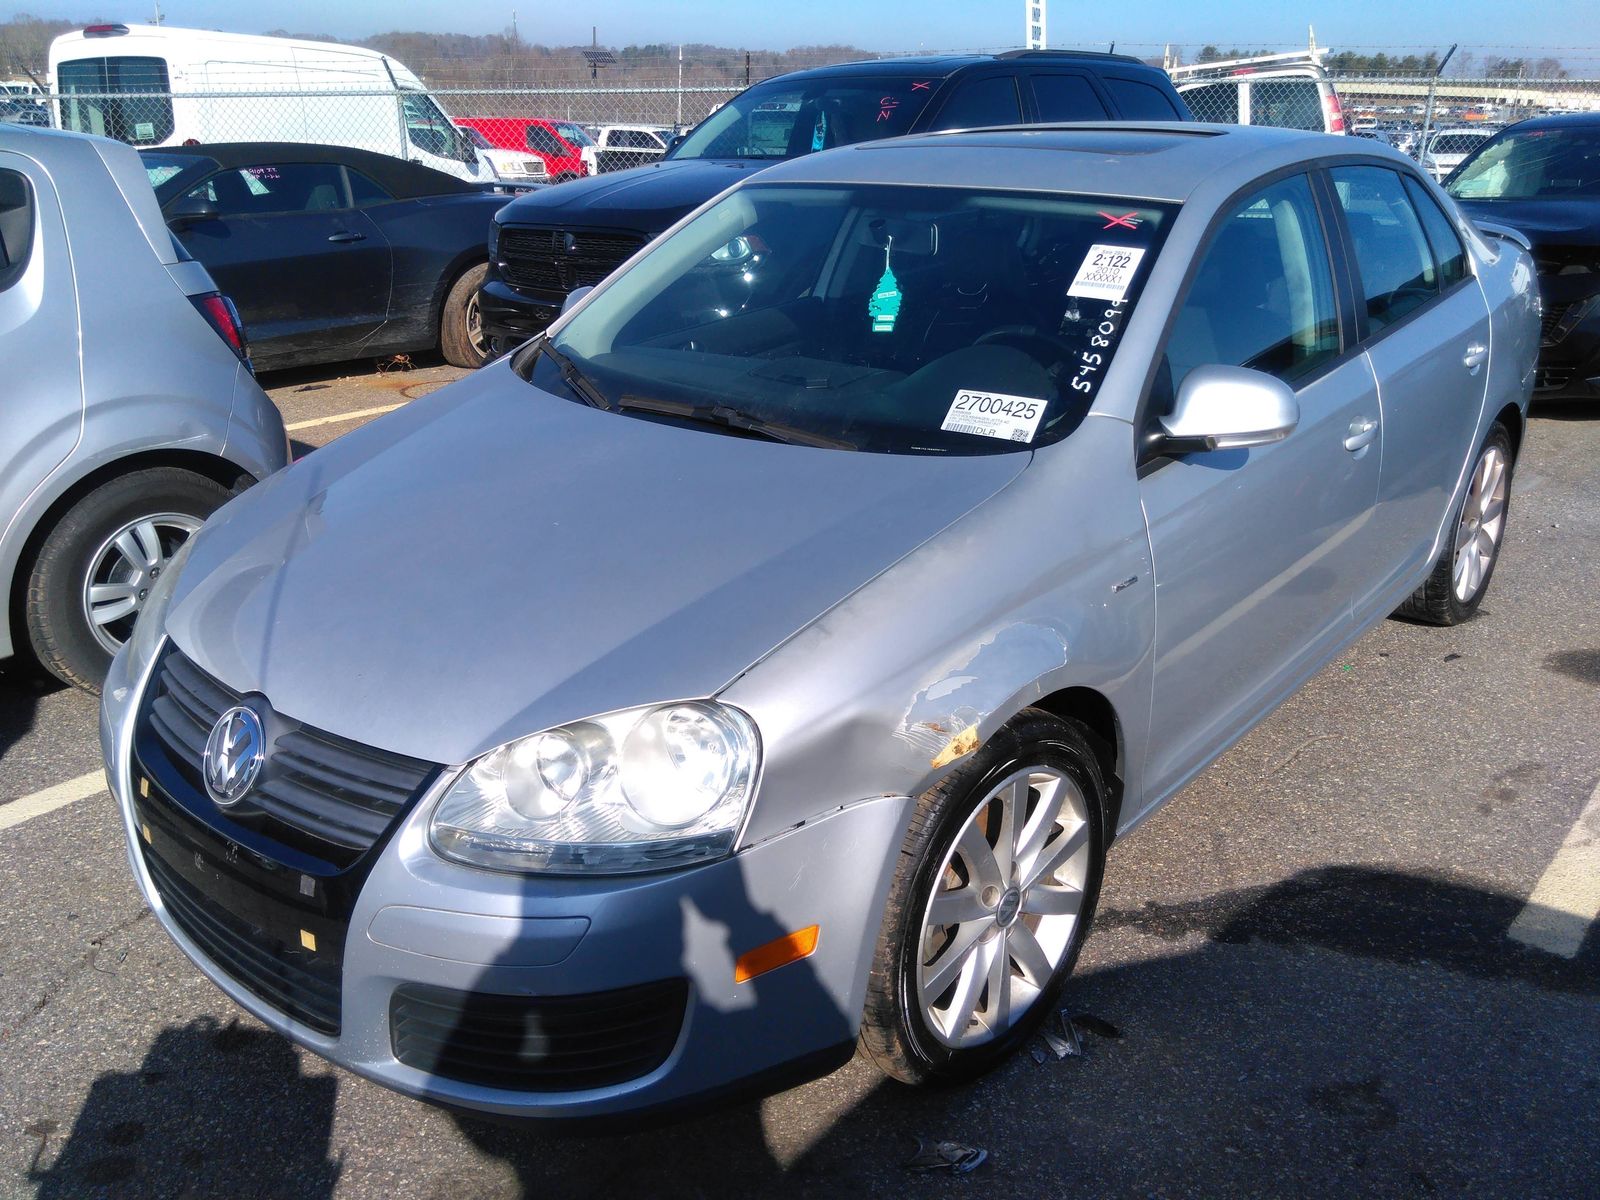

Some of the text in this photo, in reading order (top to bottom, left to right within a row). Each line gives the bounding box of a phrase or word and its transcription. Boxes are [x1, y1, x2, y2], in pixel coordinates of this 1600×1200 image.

[1092, 253, 1131, 268] 2:122
[955, 394, 1038, 420] 2700425
[975, 427, 996, 436] DLR
